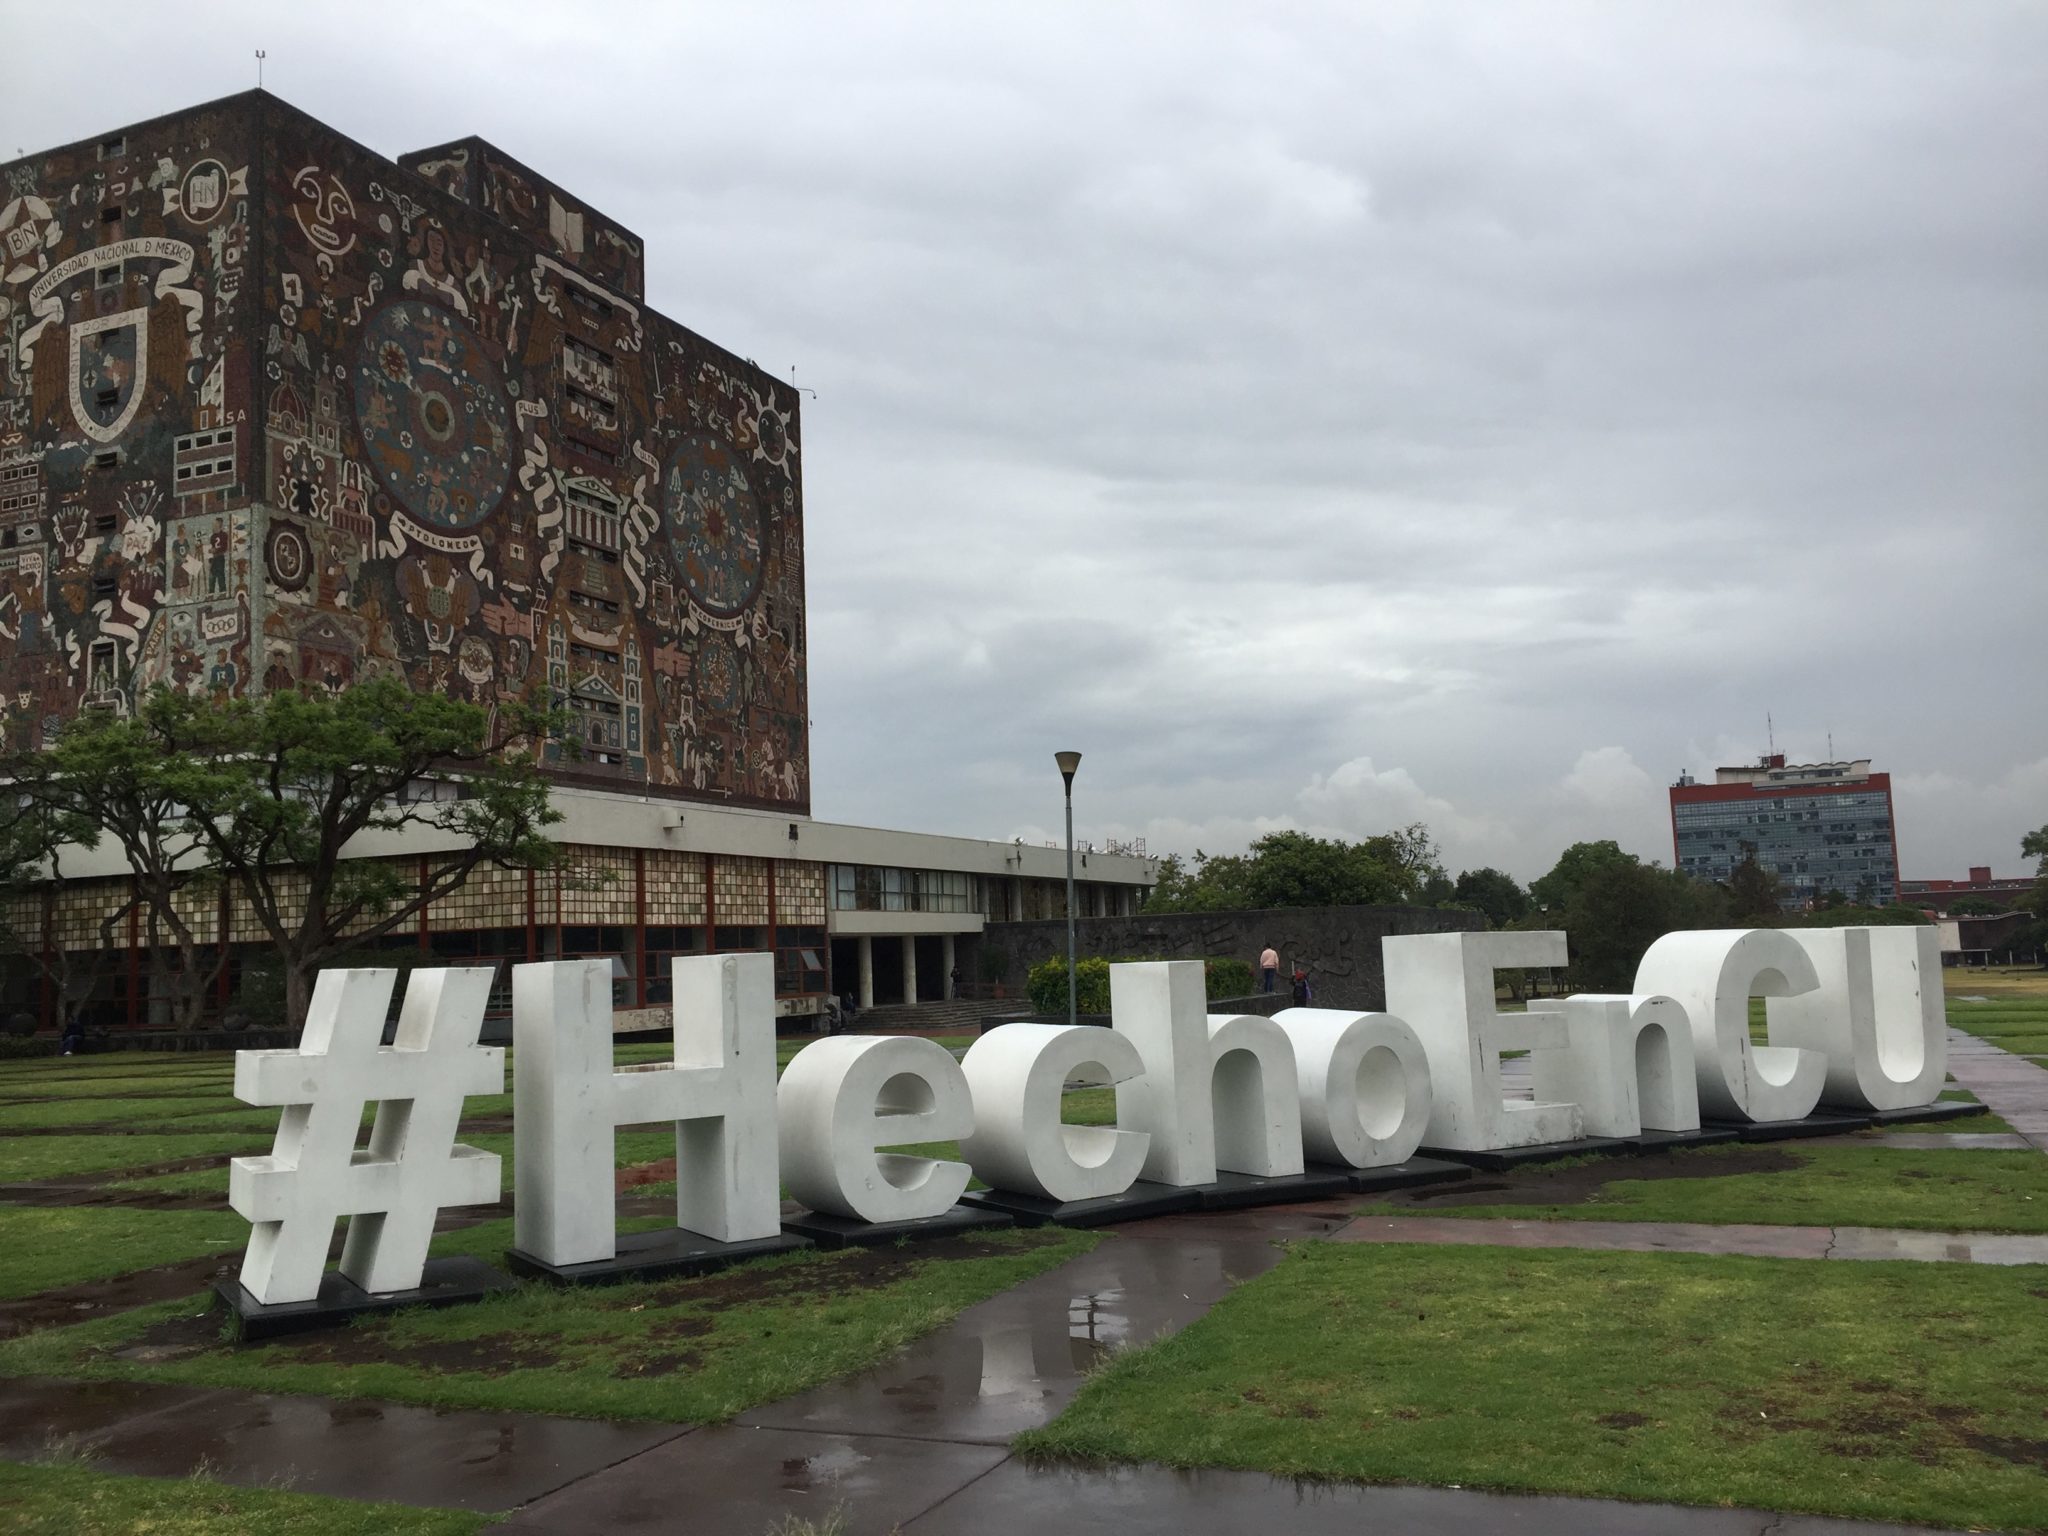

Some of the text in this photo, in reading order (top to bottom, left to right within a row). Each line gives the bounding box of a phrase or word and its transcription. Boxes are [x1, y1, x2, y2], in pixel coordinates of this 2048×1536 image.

[192, 181, 215, 204] HN
[11, 222, 36, 251] BN
[94, 243, 140, 263] NACIONAL
[155, 241, 191, 262] MEXICO
[518, 402, 539, 415] PLUS
[639, 450, 658, 467] ULTRA
[126, 535, 148, 552] PAZ
[408, 524, 469, 550] PTOLOMEO
[146, 621, 165, 655] PARIS
[229, 925, 1948, 1306] #HechoEnCU
